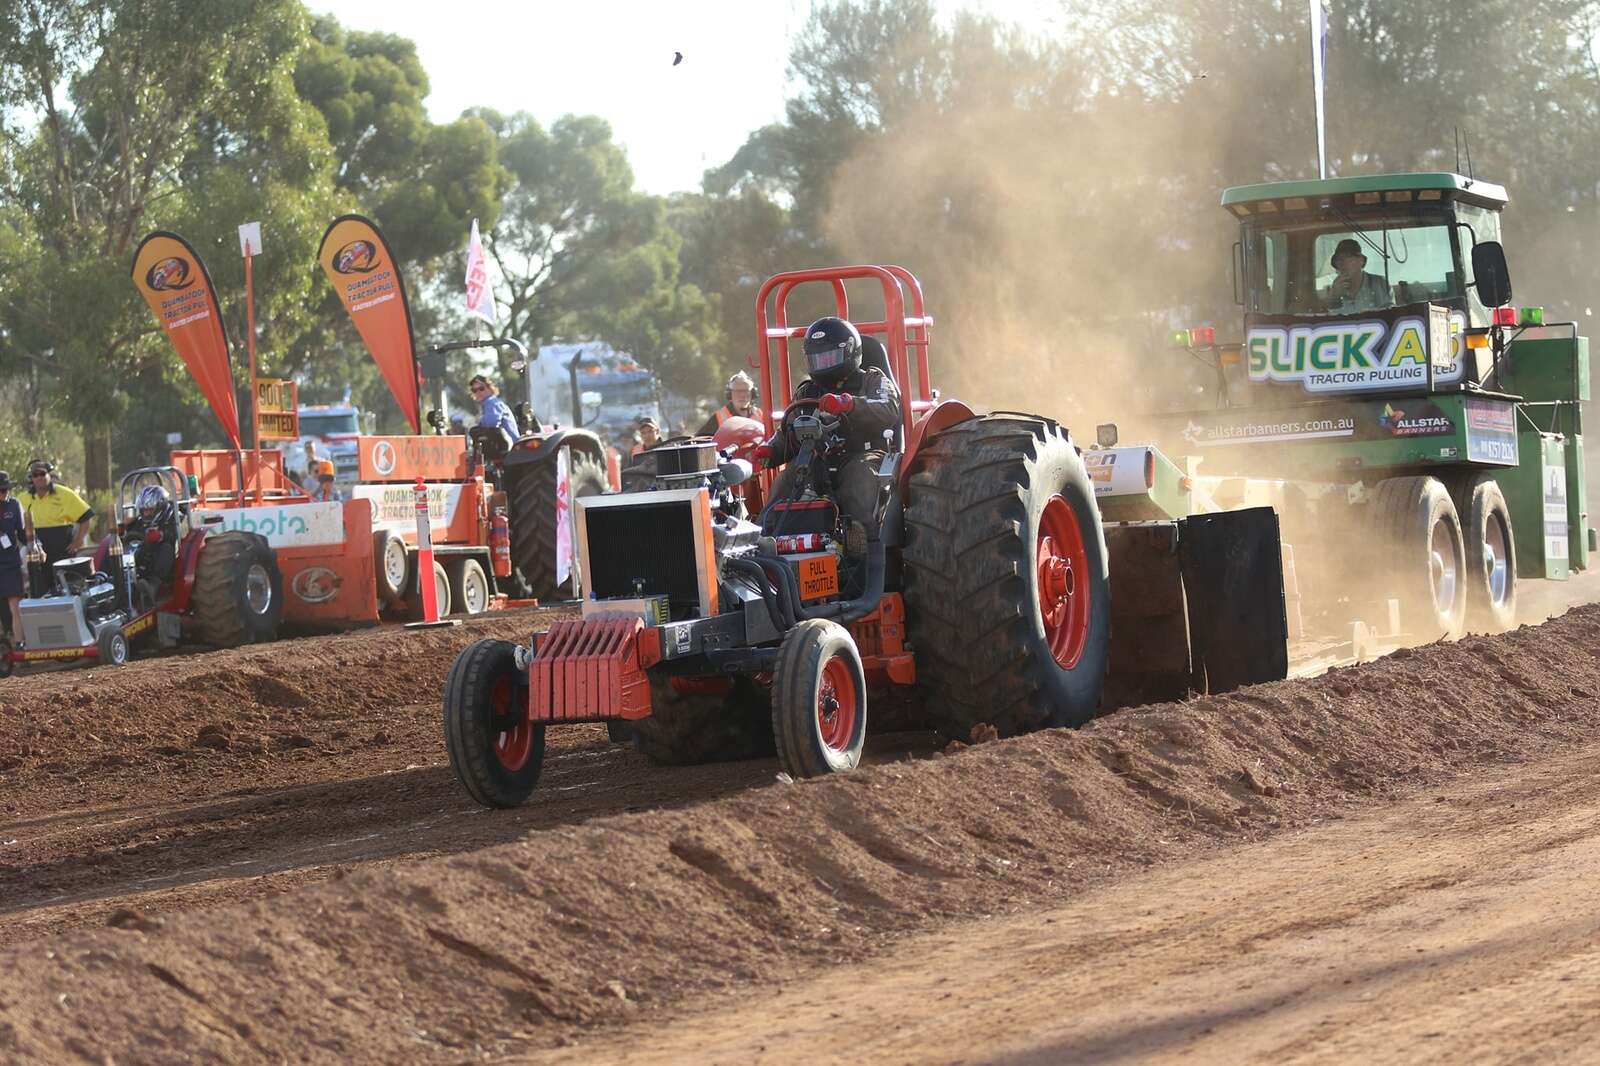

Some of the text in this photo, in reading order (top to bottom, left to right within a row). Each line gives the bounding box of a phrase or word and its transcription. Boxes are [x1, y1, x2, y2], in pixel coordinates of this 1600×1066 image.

[1251, 332, 1375, 372] SLICK
[1310, 363, 1457, 385] TRACTOR PULLING LED
[1207, 418, 1354, 438] allstarbanners.com.au
[1396, 426, 1448, 435] BANNERS
[1397, 417, 1450, 428] ALLSTAR
[809, 559, 827, 577] FULL
[804, 575, 834, 593] THROTTLE
